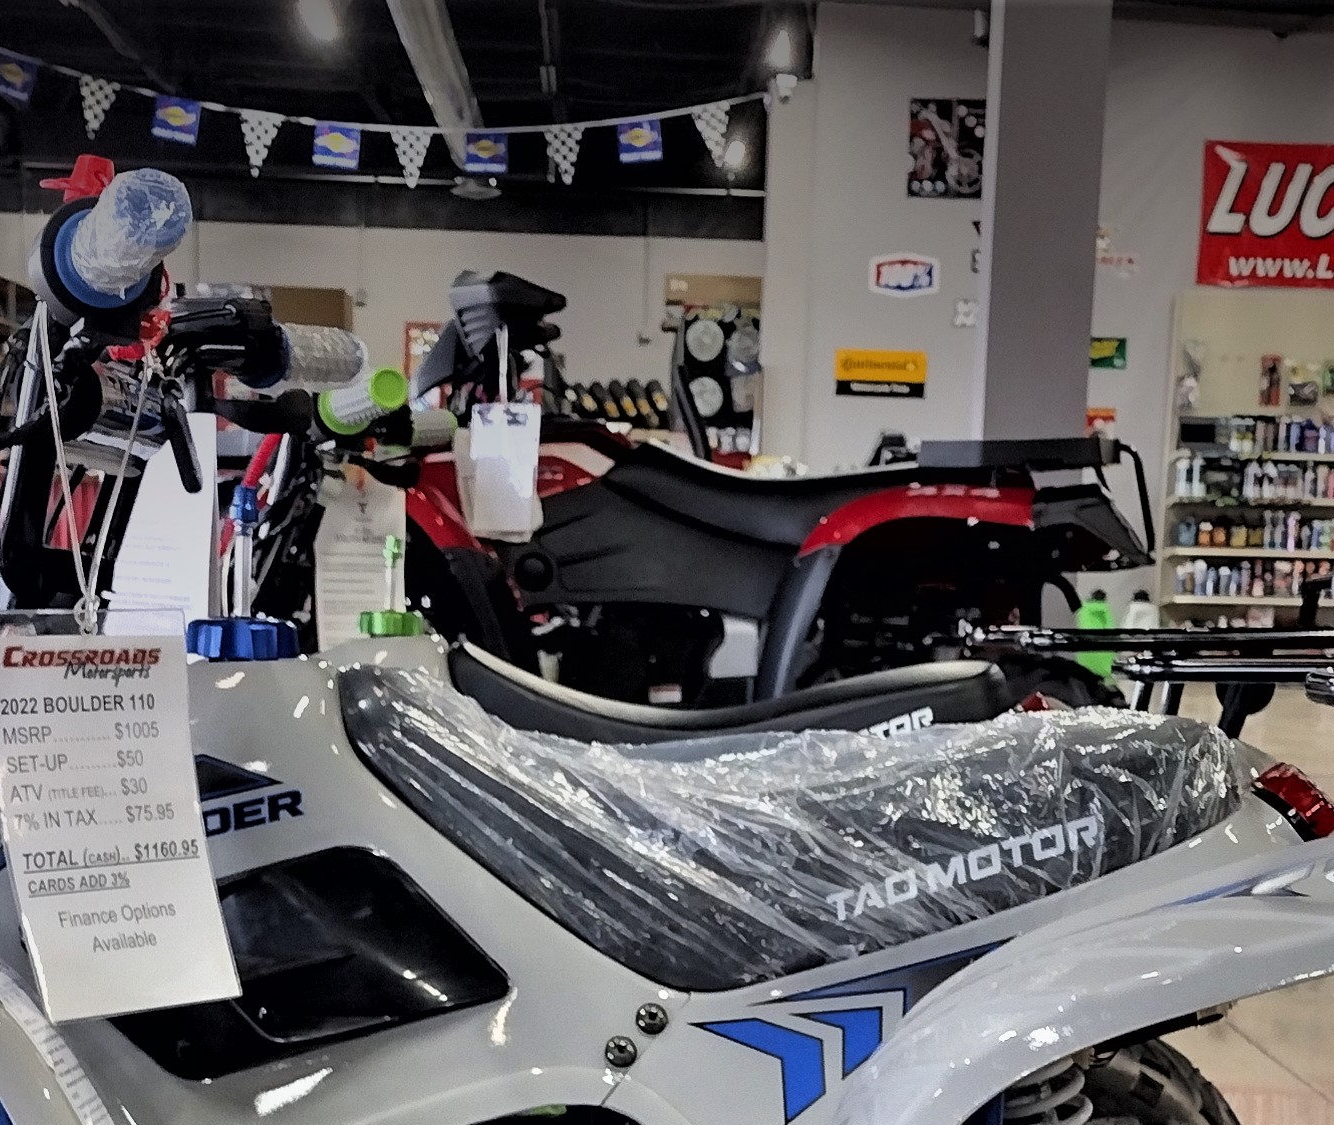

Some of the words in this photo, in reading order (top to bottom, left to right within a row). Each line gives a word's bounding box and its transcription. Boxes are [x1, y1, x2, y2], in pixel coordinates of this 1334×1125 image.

[2, 646, 162, 668] CROSSROADS
[0, 697, 39, 715] 2022
[43, 694, 125, 713] BOULDER
[129, 693, 155, 711] 110
[114, 720, 160, 740] $1005
[859, 705, 935, 741] TOR
[116, 749, 144, 768] $50
[10, 783, 43, 803] ATV
[120, 776, 148, 796] $30
[43, 811, 61, 829] IN
[125, 803, 175, 824] $75.95
[23, 850, 79, 870] TOTAL
[134, 839, 199, 862] $1160.95
[825, 867, 918, 921] TAO
[924, 814, 1100, 895] MOTOR
[28, 876, 76, 896] CARDS
[79, 873, 108, 890] ADD
[111, 871, 131, 888] 3%
[57, 907, 117, 928] Finance
[121, 901, 176, 924] Options
[92, 930, 158, 953] Available
